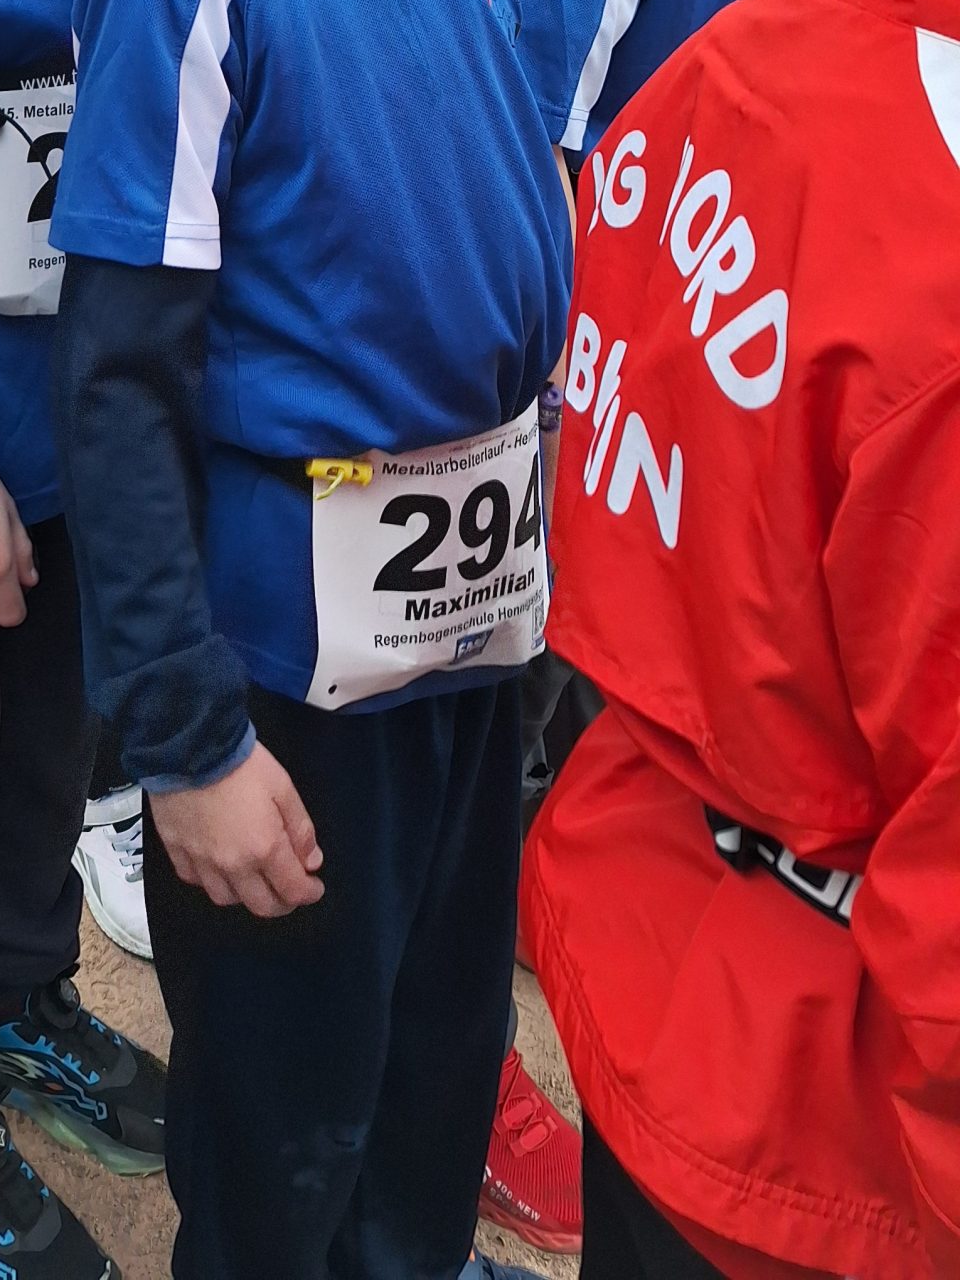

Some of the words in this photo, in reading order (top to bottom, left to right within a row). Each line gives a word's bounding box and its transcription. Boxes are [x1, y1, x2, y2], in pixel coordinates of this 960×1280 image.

[29, 255, 66, 270] Regen
[373, 450, 541, 591] 294
[405, 567, 535, 621] Maximilian
[374, 612, 495, 648] Regenbogenschule
